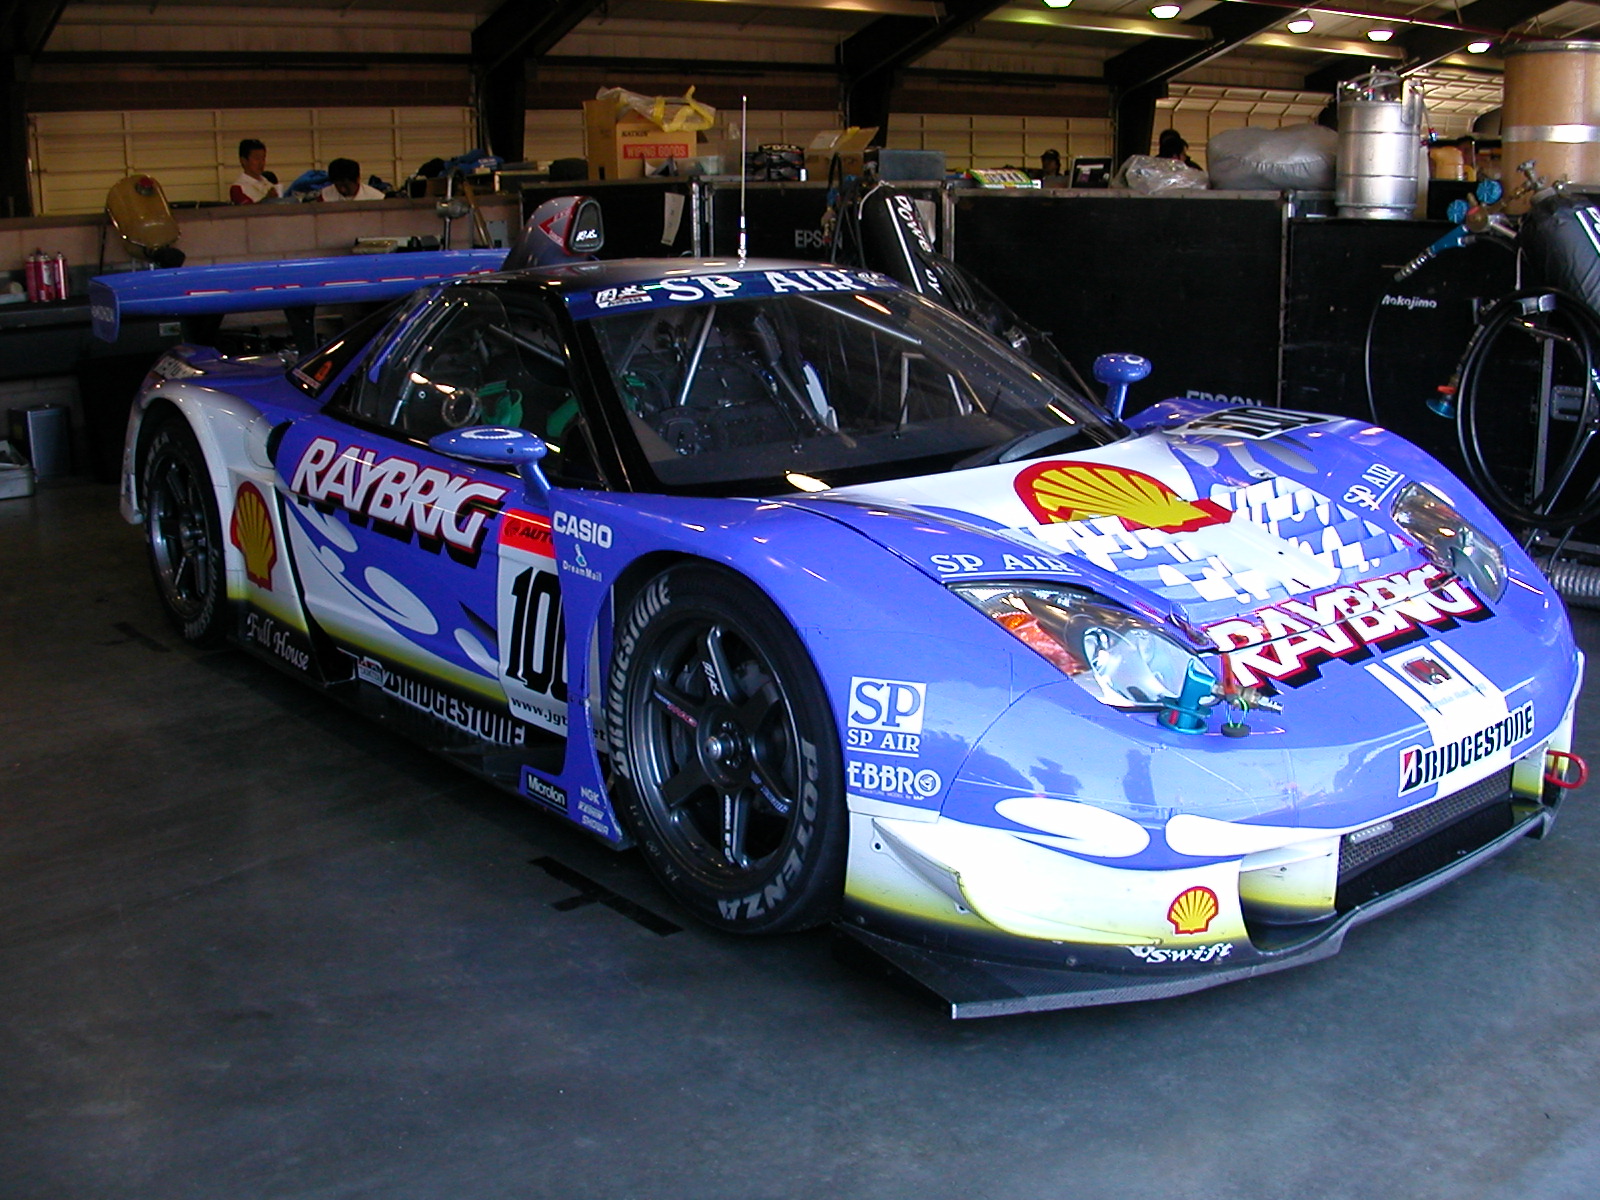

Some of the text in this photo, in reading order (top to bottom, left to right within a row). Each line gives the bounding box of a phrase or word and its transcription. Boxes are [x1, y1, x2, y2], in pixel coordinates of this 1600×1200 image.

[626, 145, 687, 158] WIPING GOODS
[795, 229, 843, 250] EPSN
[659, 274, 742, 302] SP
[763, 269, 867, 293] AIR
[289, 435, 510, 555] RAYBRIG
[1343, 463, 1399, 512] SP AIR
[553, 510, 613, 549] CASIO
[930, 553, 1075, 573] SP AIR
[246, 612, 310, 671] Full House
[1203, 561, 1482, 690] RAYBRIG
[606, 573, 673, 781] BRIDGESTONE
[382, 670, 527, 746] BRIDGESTONE
[851, 681, 921, 727] SP
[847, 729, 921, 752] SP AIR
[1400, 704, 1533, 793] BRIDGESTONE
[528, 773, 567, 807] Microlon
[580, 785, 601, 806] NGK
[847, 760, 942, 797] EBBRO
[716, 736, 819, 921] POTENZA
